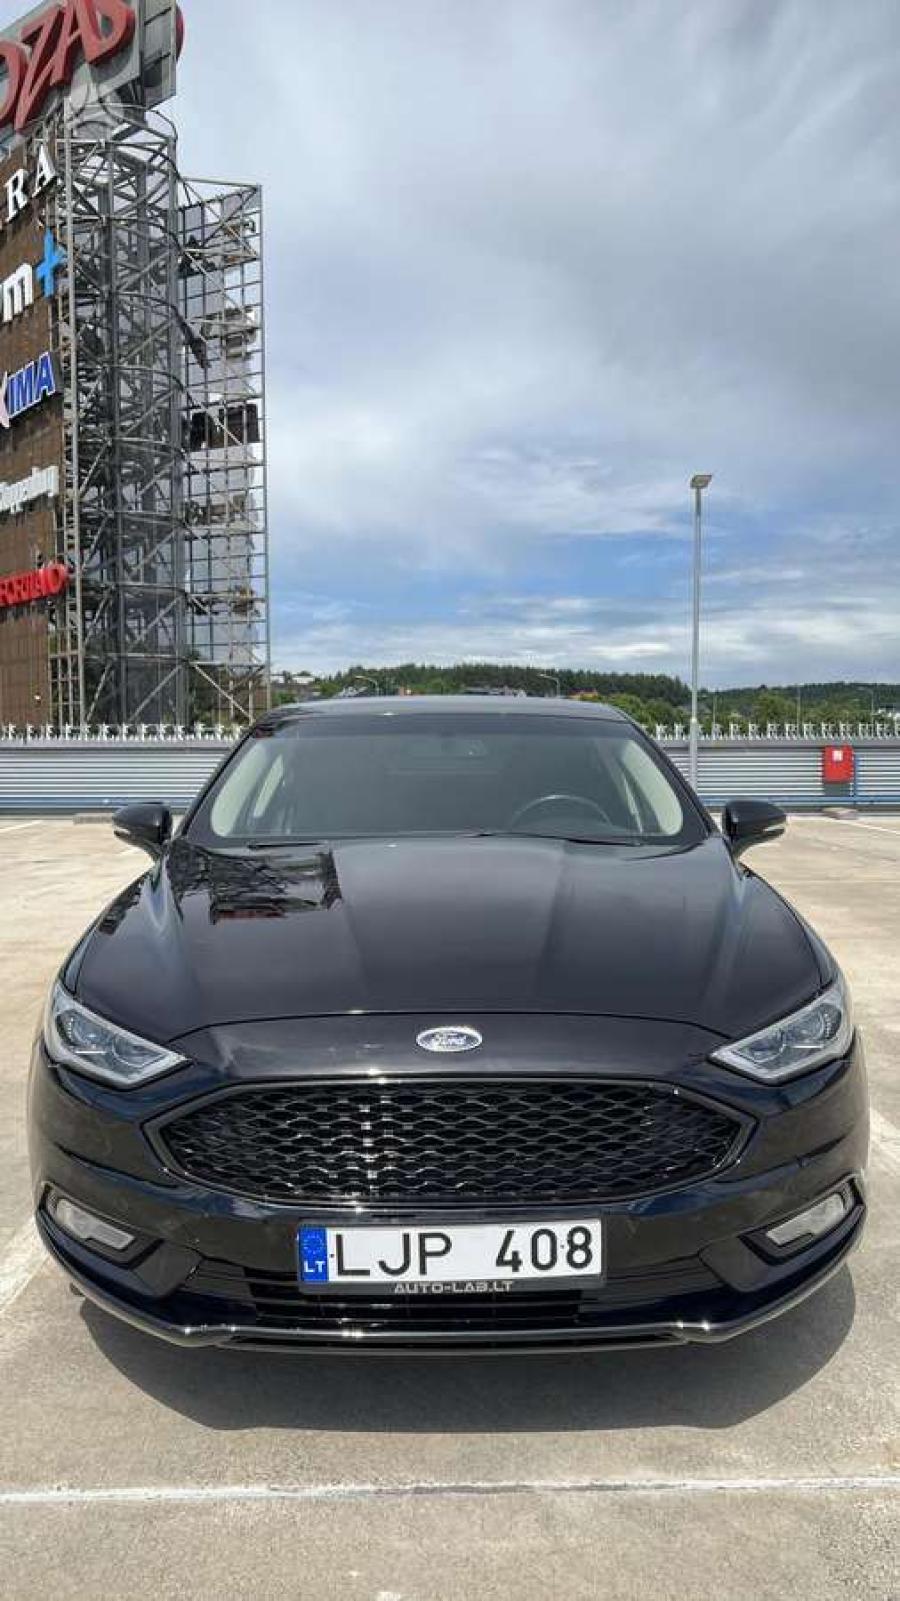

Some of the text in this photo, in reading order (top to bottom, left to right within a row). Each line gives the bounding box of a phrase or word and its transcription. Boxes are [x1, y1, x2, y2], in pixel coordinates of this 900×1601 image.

[0, 145, 56, 228] RA
[0, 226, 68, 322] m+
[303, 1260, 326, 1273] LT
[335, 1225, 593, 1277] LJP 408
[394, 1281, 514, 1294] AUTO-LAB.LT
